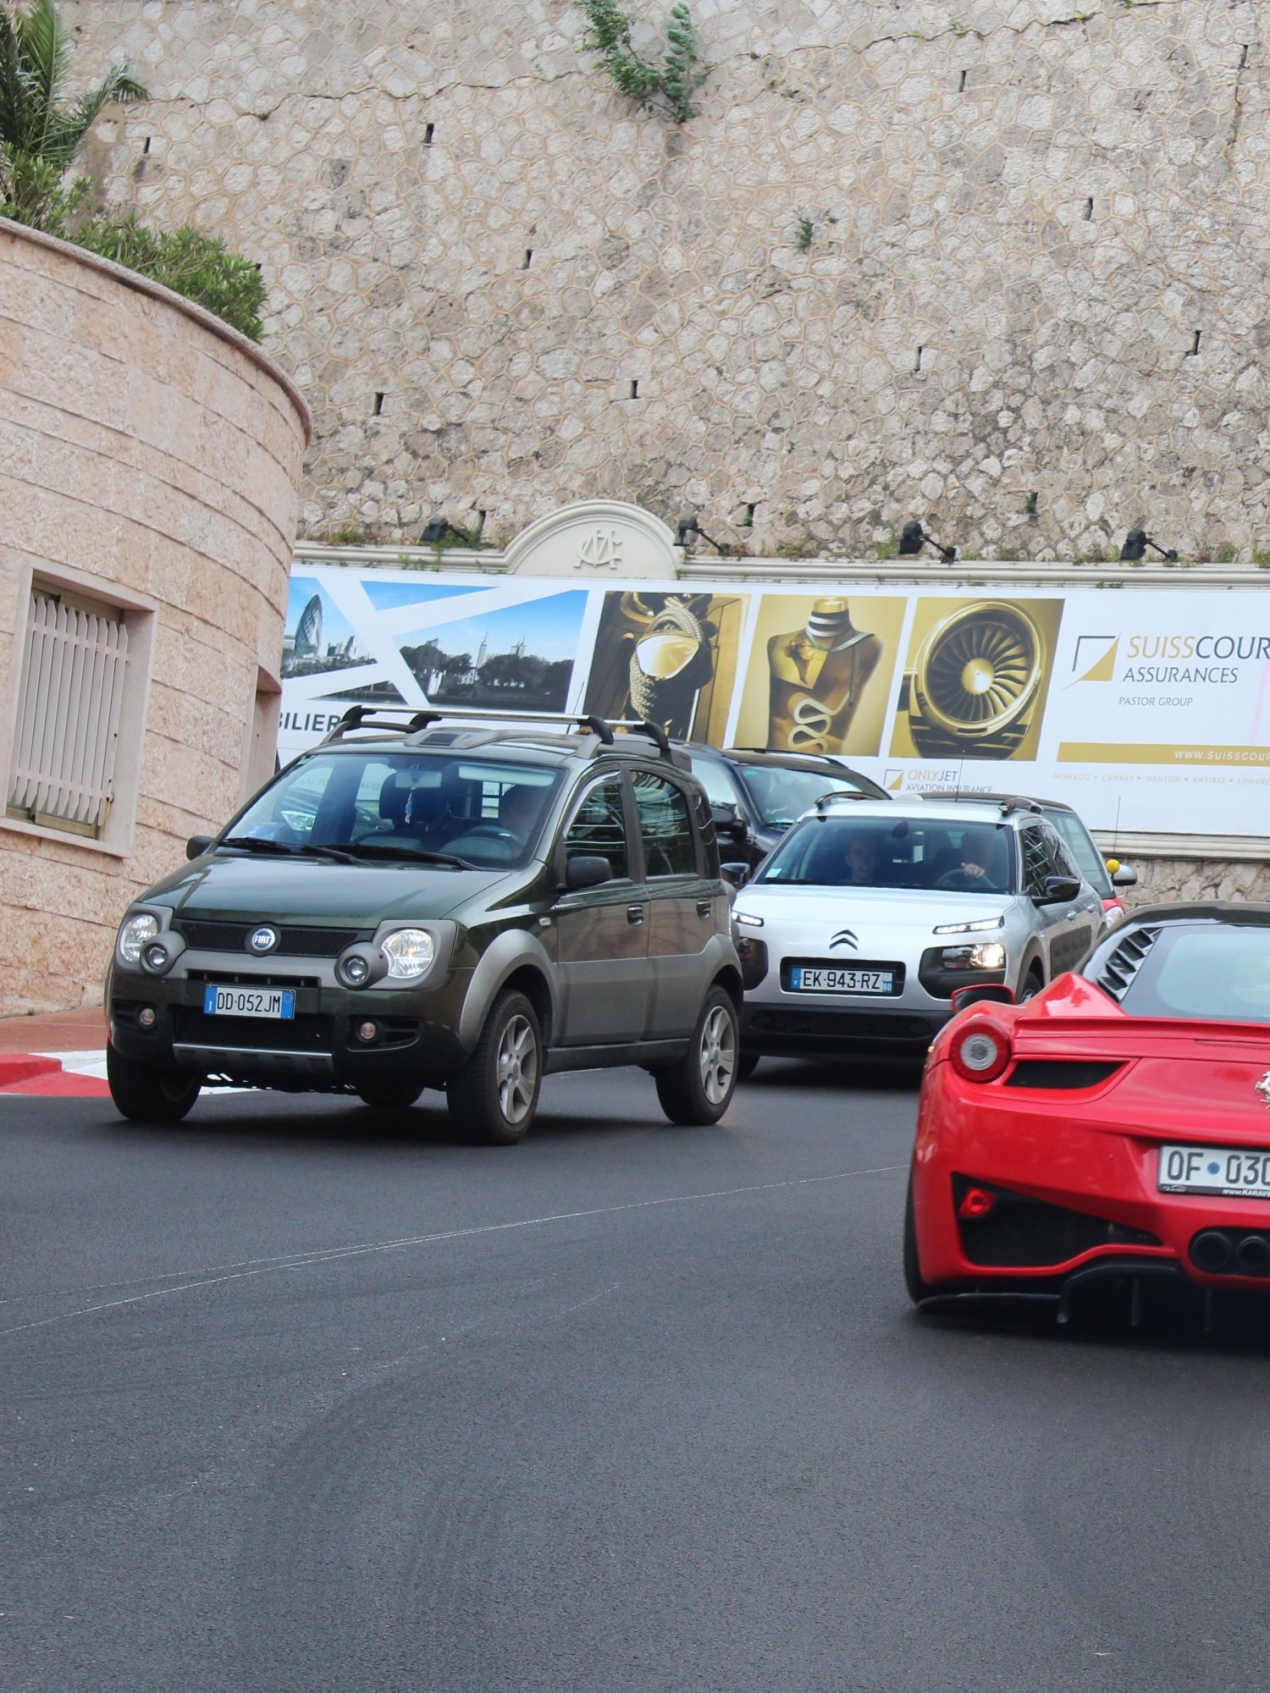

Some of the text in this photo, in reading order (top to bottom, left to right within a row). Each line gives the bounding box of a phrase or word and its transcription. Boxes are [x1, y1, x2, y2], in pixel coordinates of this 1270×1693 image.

[1122, 666, 1239, 685] ASSURANCES
[1118, 696, 1193, 708] PASTOR GROUP
[254, 935, 271, 944] FIAT
[803, 970, 881, 990] EK-943-RZ
[1167, 1150, 1203, 1181] OF
